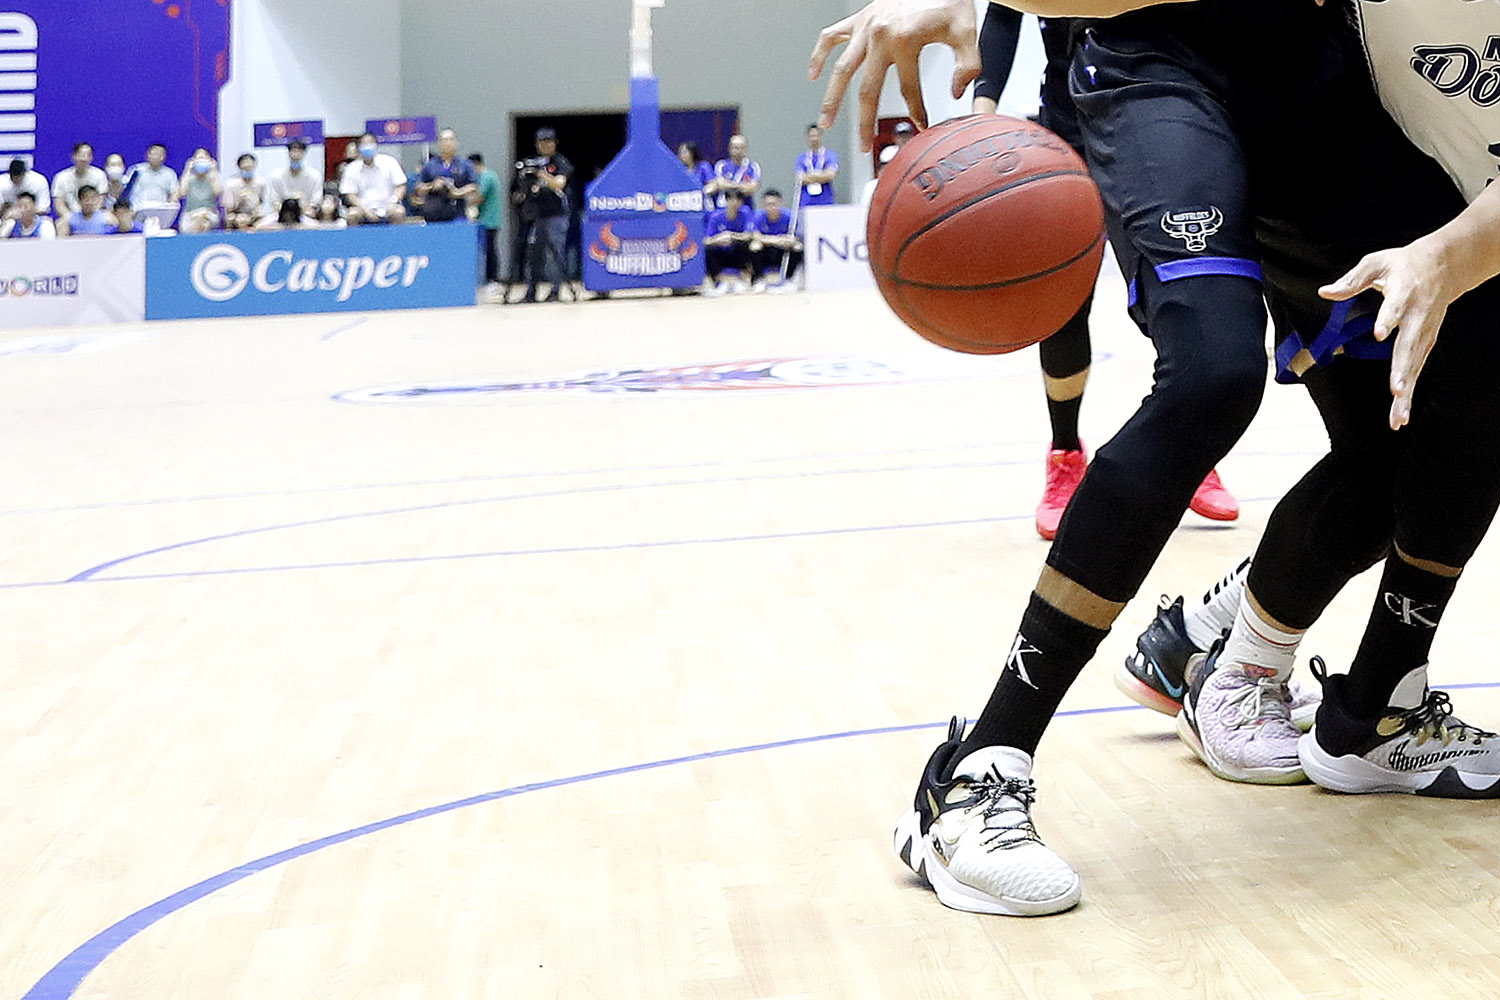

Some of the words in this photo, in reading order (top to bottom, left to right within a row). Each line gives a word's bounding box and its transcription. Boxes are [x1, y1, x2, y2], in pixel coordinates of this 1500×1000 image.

[818, 235, 870, 263] No
[253, 249, 430, 303] Casper
[1384, 591, 1438, 629] CK
